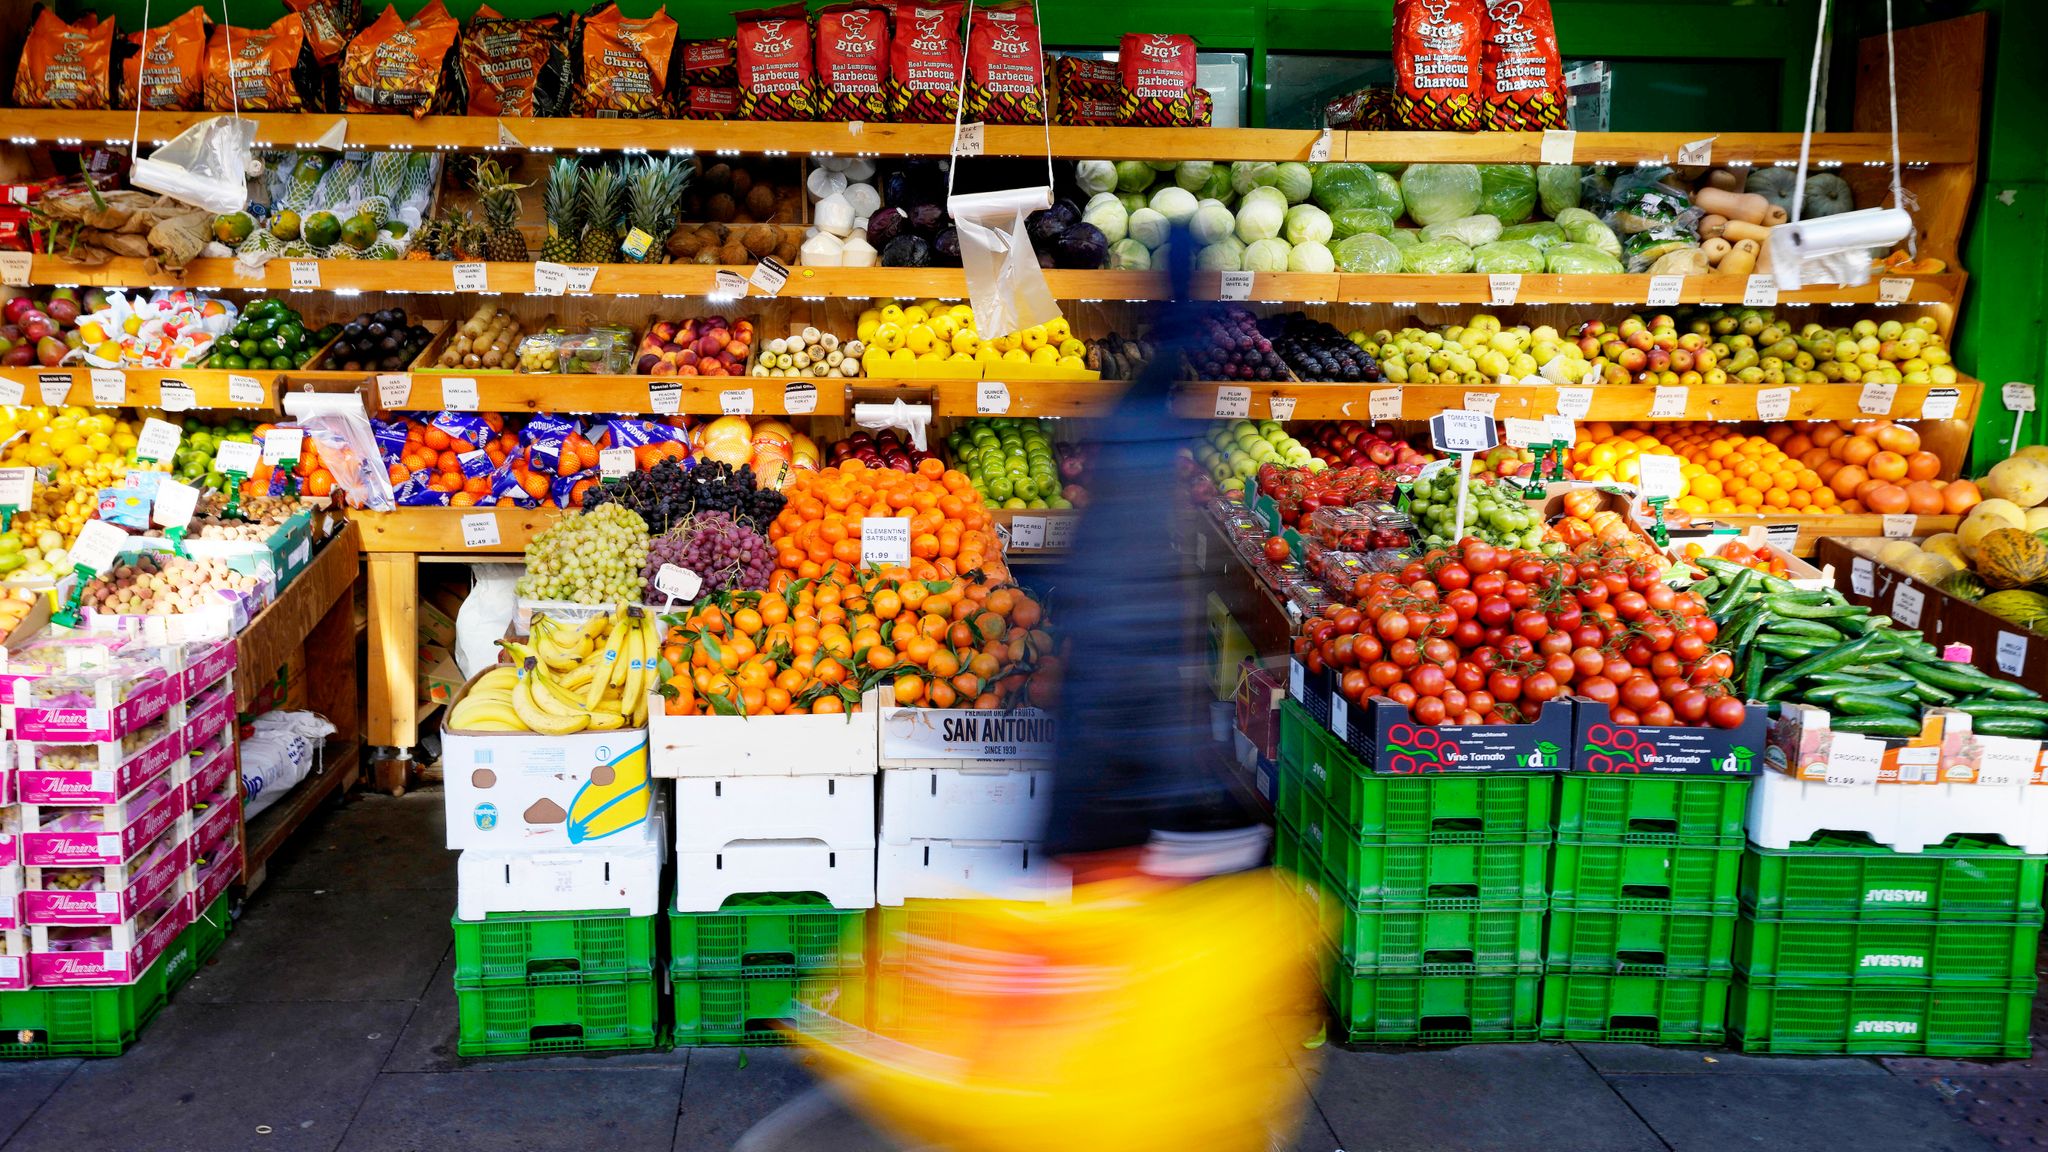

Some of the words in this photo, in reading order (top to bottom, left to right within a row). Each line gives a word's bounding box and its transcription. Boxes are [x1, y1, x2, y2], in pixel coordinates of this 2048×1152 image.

[1418, 22, 1447, 38] BIG
[1448, 22, 1465, 35] K
[1494, 33, 1523, 44] BIG
[1523, 29, 1537, 40] K
[753, 42, 780, 53] BIG
[781, 38, 794, 50] K
[835, 40, 862, 53] BIG
[863, 39, 876, 51] K
[911, 39, 938, 51] BIG
[938, 39, 948, 50] K
[991, 39, 1017, 53] BIG
[1017, 40, 1030, 53] K
[1141, 44, 1168, 57] BIG
[1170, 45, 1182, 56] K
[604, 49, 635, 58] Instant
[1414, 54, 1432, 62] Real
[1433, 53, 1467, 62] Lumpwood
[480, 57, 532, 73] Charcoal
[603, 56, 648, 69] Charc
[766, 62, 799, 71] Lumpwood
[924, 61, 953, 69] Lumpwood
[1511, 57, 1546, 65] Lumpwood
[229, 68, 272, 77] Charcoal
[909, 68, 954, 80] Barbecue
[1003, 64, 1033, 72] Lumpwood
[1152, 69, 1184, 77] Lumpwood
[1414, 62, 1469, 75] Barbecue
[1496, 67, 1546, 80] Barbecue
[45, 72, 86, 81] Charcoal
[141, 74, 182, 85] Charcoal
[618, 70, 624, 78] 4
[626, 71, 650, 80] PACK
[753, 71, 799, 82] Barbecue
[832, 71, 878, 81] Barbecue
[988, 70, 1034, 83] Barbecue
[1138, 76, 1184, 86] Barbecue
[753, 81, 800, 94] Charcoal
[834, 83, 879, 93] Charcoal
[909, 79, 954, 92] Charcoal
[988, 82, 1034, 94] Charcoal
[1414, 76, 1468, 89] Charcoal
[1496, 78, 1549, 93] Charcoal
[1137, 88, 1184, 99] Charcoal
[763, 259, 778, 271] Special
[537, 268, 564, 277] PINEAPPLE
[623, 422, 649, 444] PODIUM
[943, 718, 976, 742] SAN
[982, 719, 1055, 742] ANTONIO
[985, 746, 1001, 755] SINCE
[1003, 746, 1016, 755] 1930
[1447, 753, 1468, 761] Vine
[1470, 753, 1505, 761] Tomato
[1643, 754, 1664, 763] Vine
[1665, 754, 1701, 764] Tomato
[1864, 889, 1927, 903] HASRAF
[1860, 955, 1924, 968] HASRAF
[1854, 1021, 1918, 1034] HASRAF
